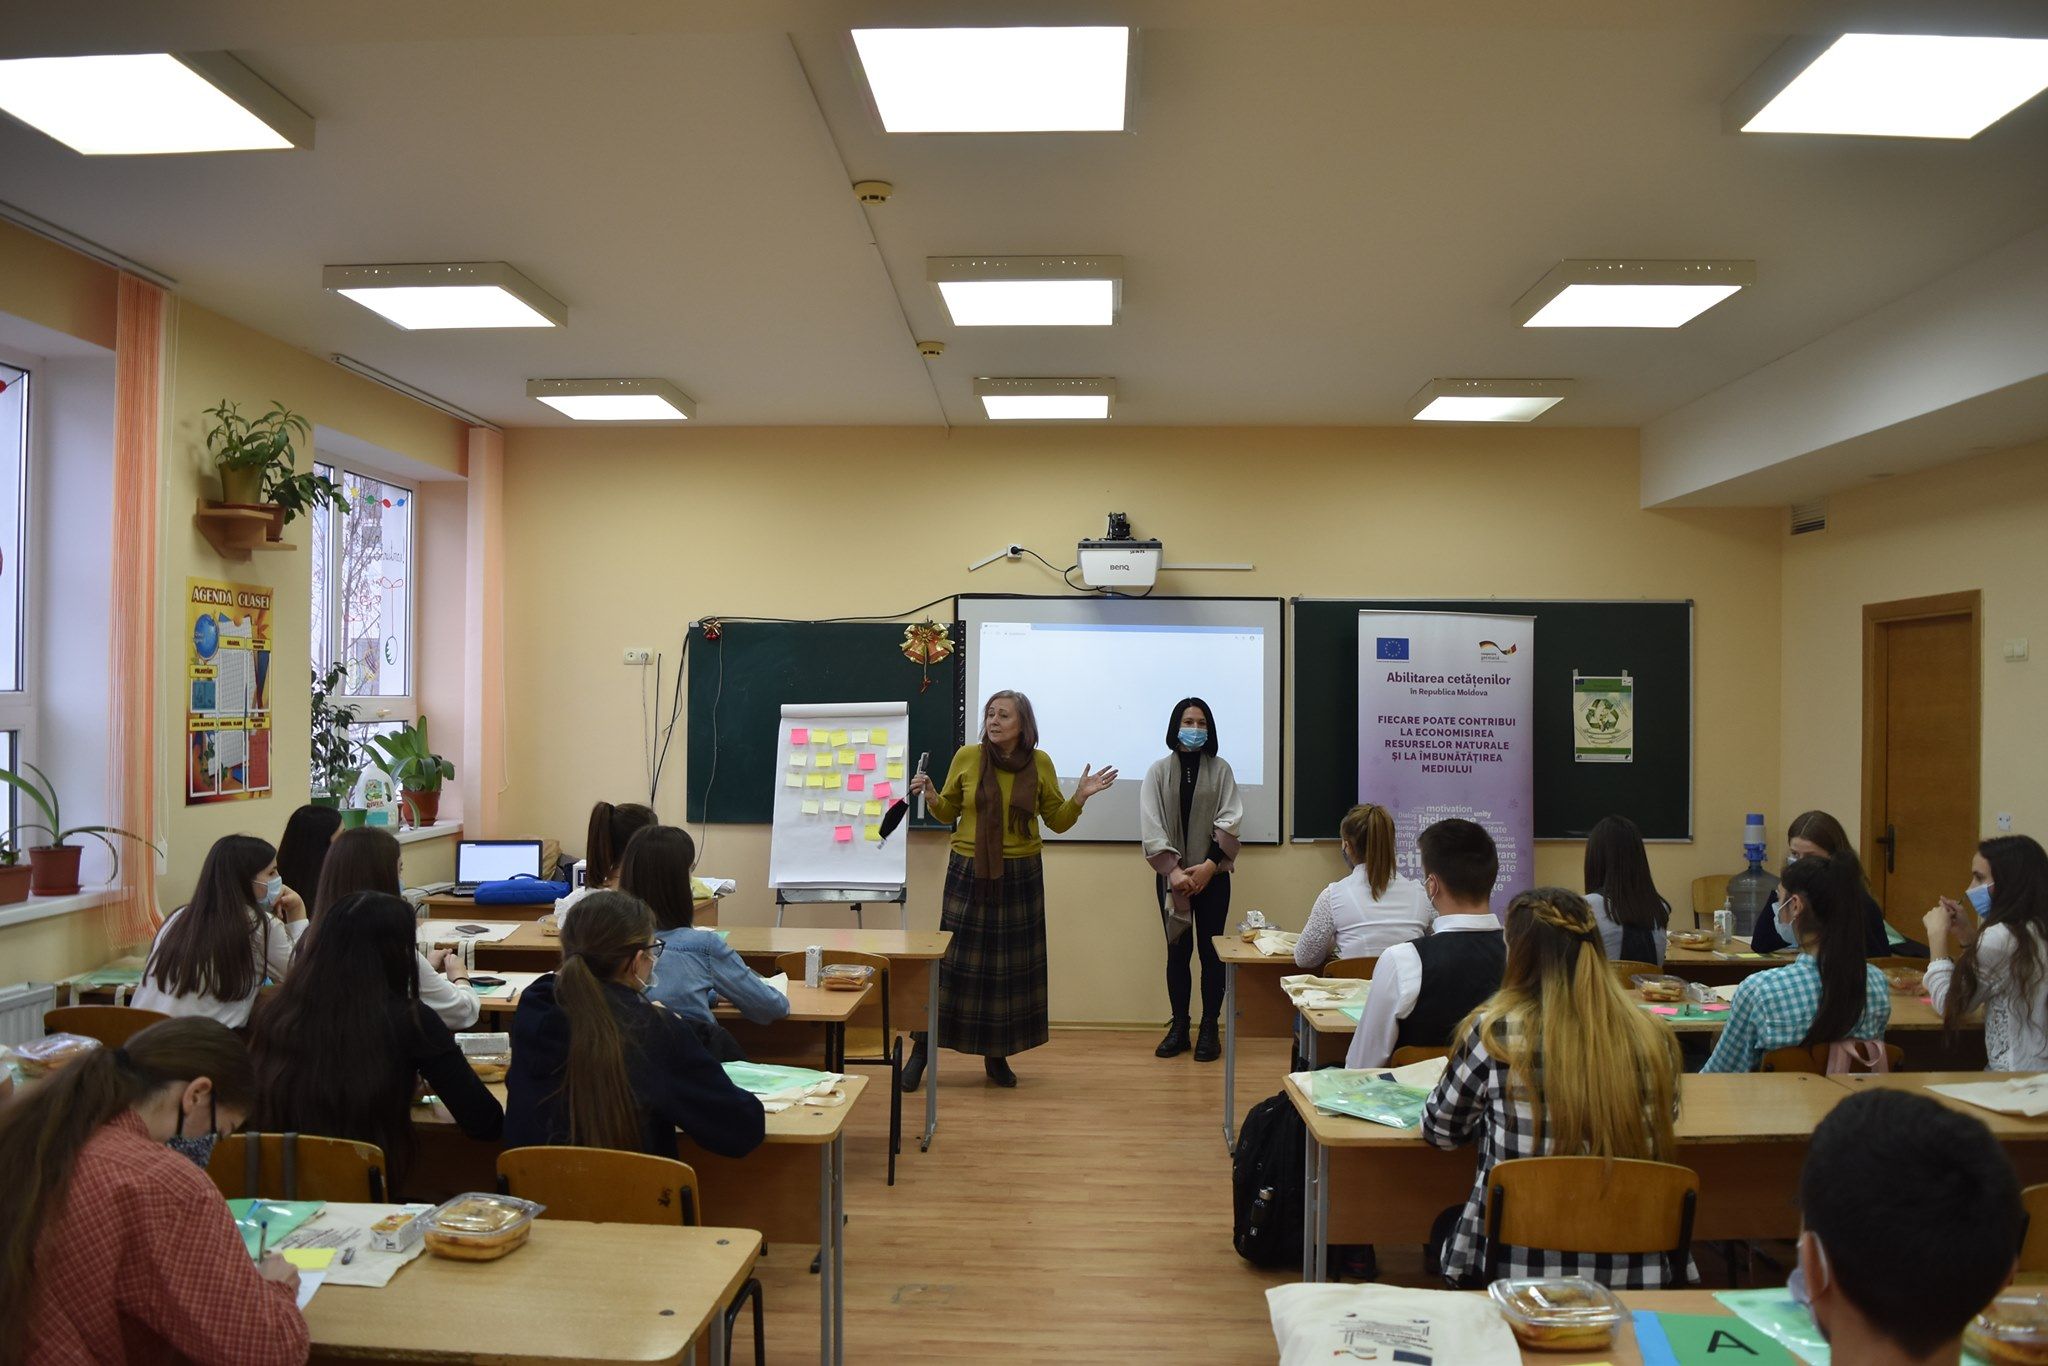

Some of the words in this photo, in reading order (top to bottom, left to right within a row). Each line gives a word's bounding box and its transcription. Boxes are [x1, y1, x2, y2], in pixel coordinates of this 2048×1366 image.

[192, 586, 233, 606] AGENDA
[237, 593, 270, 611] CLASEI
[1386, 672, 1445, 684] Abilitarea
[1447, 672, 1511, 687] cetățenilor
[1419, 688, 1456, 697] Republica
[1377, 715, 1420, 725] FIECARE
[1423, 716, 1456, 725] POATE
[1458, 717, 1516, 726] CONTRIBUI
[1400, 728, 1413, 736] LA
[1415, 728, 1494, 738] ECONOMISIREA
[1385, 740, 1453, 749] RESURSELOR
[1455, 741, 1510, 750] NATURALE
[1392, 752, 1401, 762] ȘI
[1404, 752, 1417, 761] LA
[1419, 750, 1503, 764] ÎMBUNĂTĂȚIREA
[1421, 764, 1472, 774] MEDIULUI
[1426, 804, 1473, 813] motivation
[1498, 851, 1517, 860] rare
[1707, 1330, 1759, 1355] A
